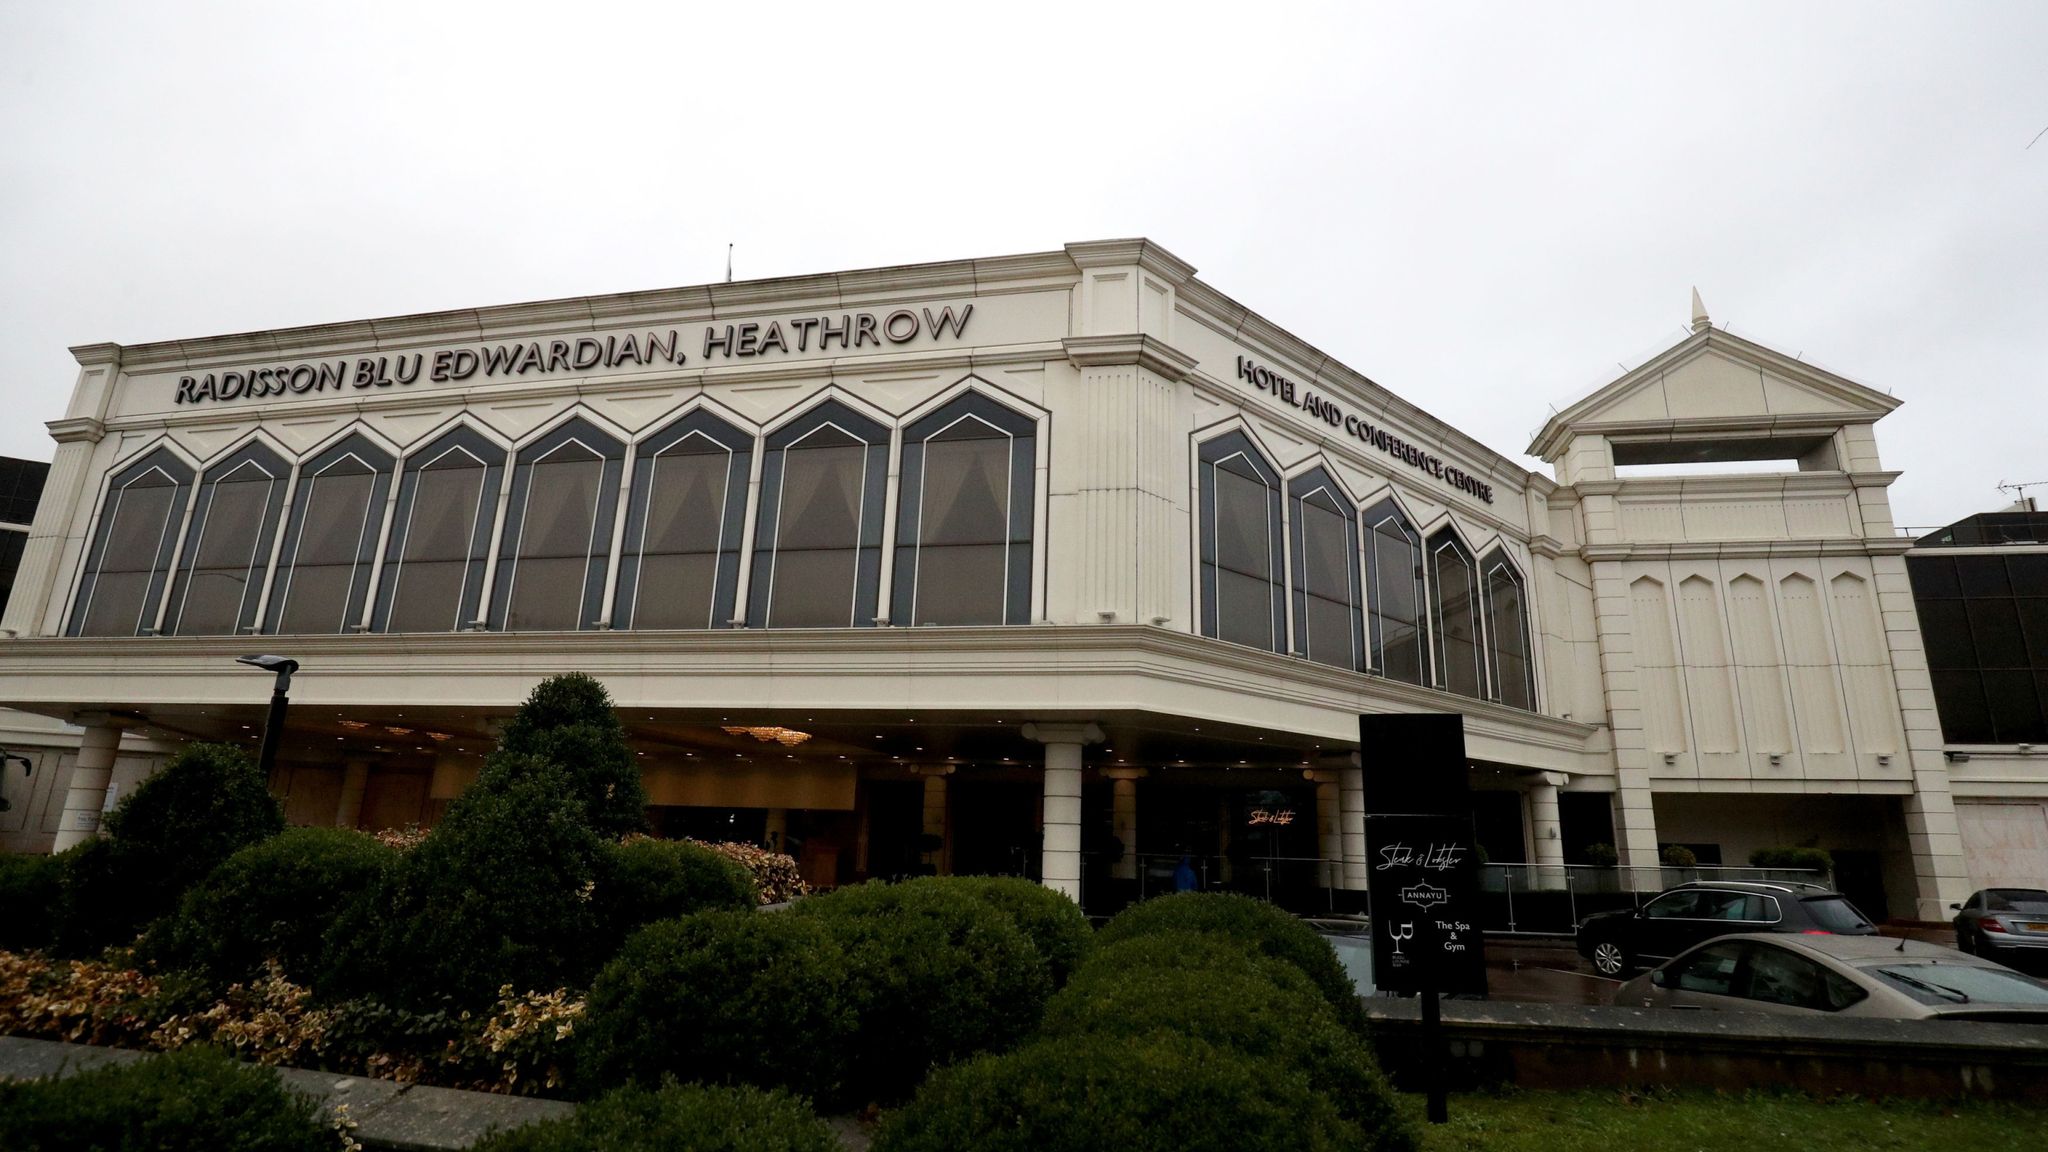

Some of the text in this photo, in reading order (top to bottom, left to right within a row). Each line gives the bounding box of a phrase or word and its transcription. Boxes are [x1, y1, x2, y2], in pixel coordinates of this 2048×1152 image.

[174, 304, 973, 404] RADISSON BLU EDWARDIAN, HEATHROW
[1238, 355, 1494, 504] HOTEL AND CONFERENCE CENTRE
[1435, 920, 1470, 932] The Spa
[1450, 931, 1457, 940] &
[1444, 941, 1465, 952] Gym
